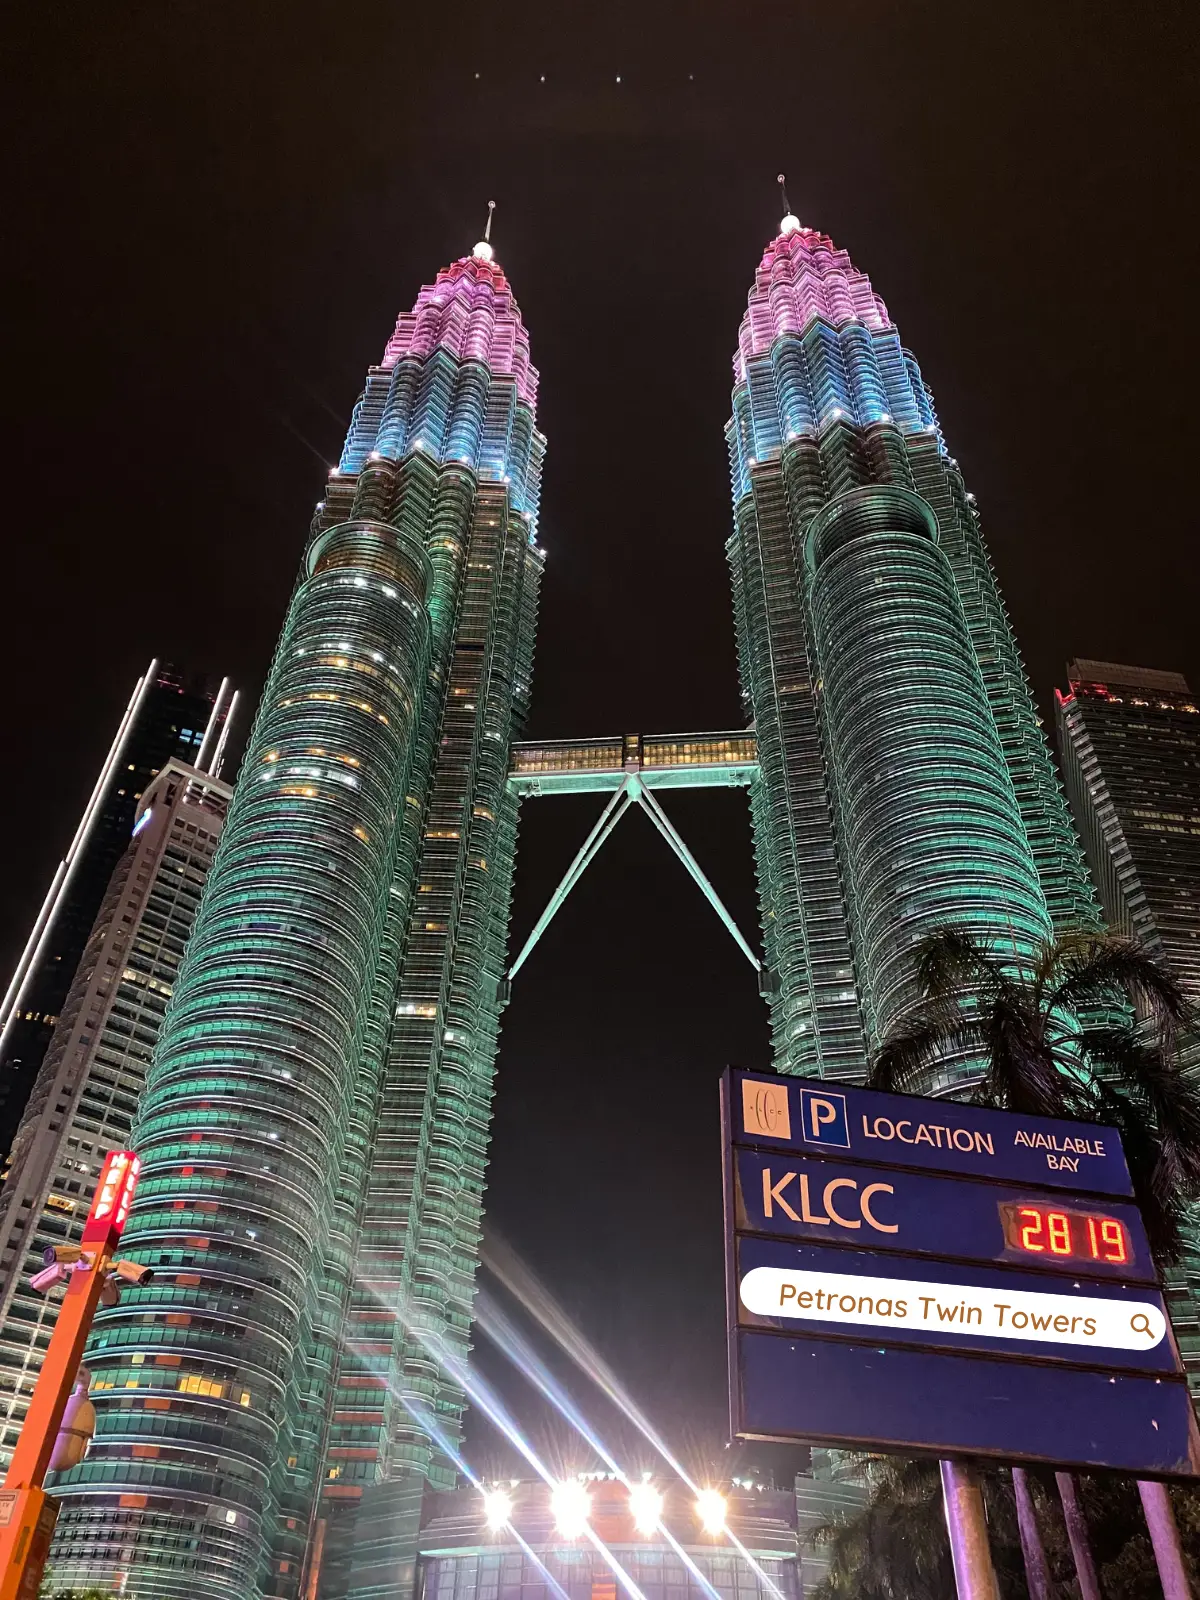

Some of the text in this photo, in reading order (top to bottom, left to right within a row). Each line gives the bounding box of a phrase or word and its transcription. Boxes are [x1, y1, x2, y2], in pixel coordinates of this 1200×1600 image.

[810, 1098, 836, 1137] P
[862, 1115, 995, 1155] LOCATION
[1014, 1130, 1106, 1157] AVAILABLE
[1046, 1154, 1080, 1173] BAY
[762, 1168, 899, 1233] KLCC
[1018, 1209, 1126, 1263] 2819
